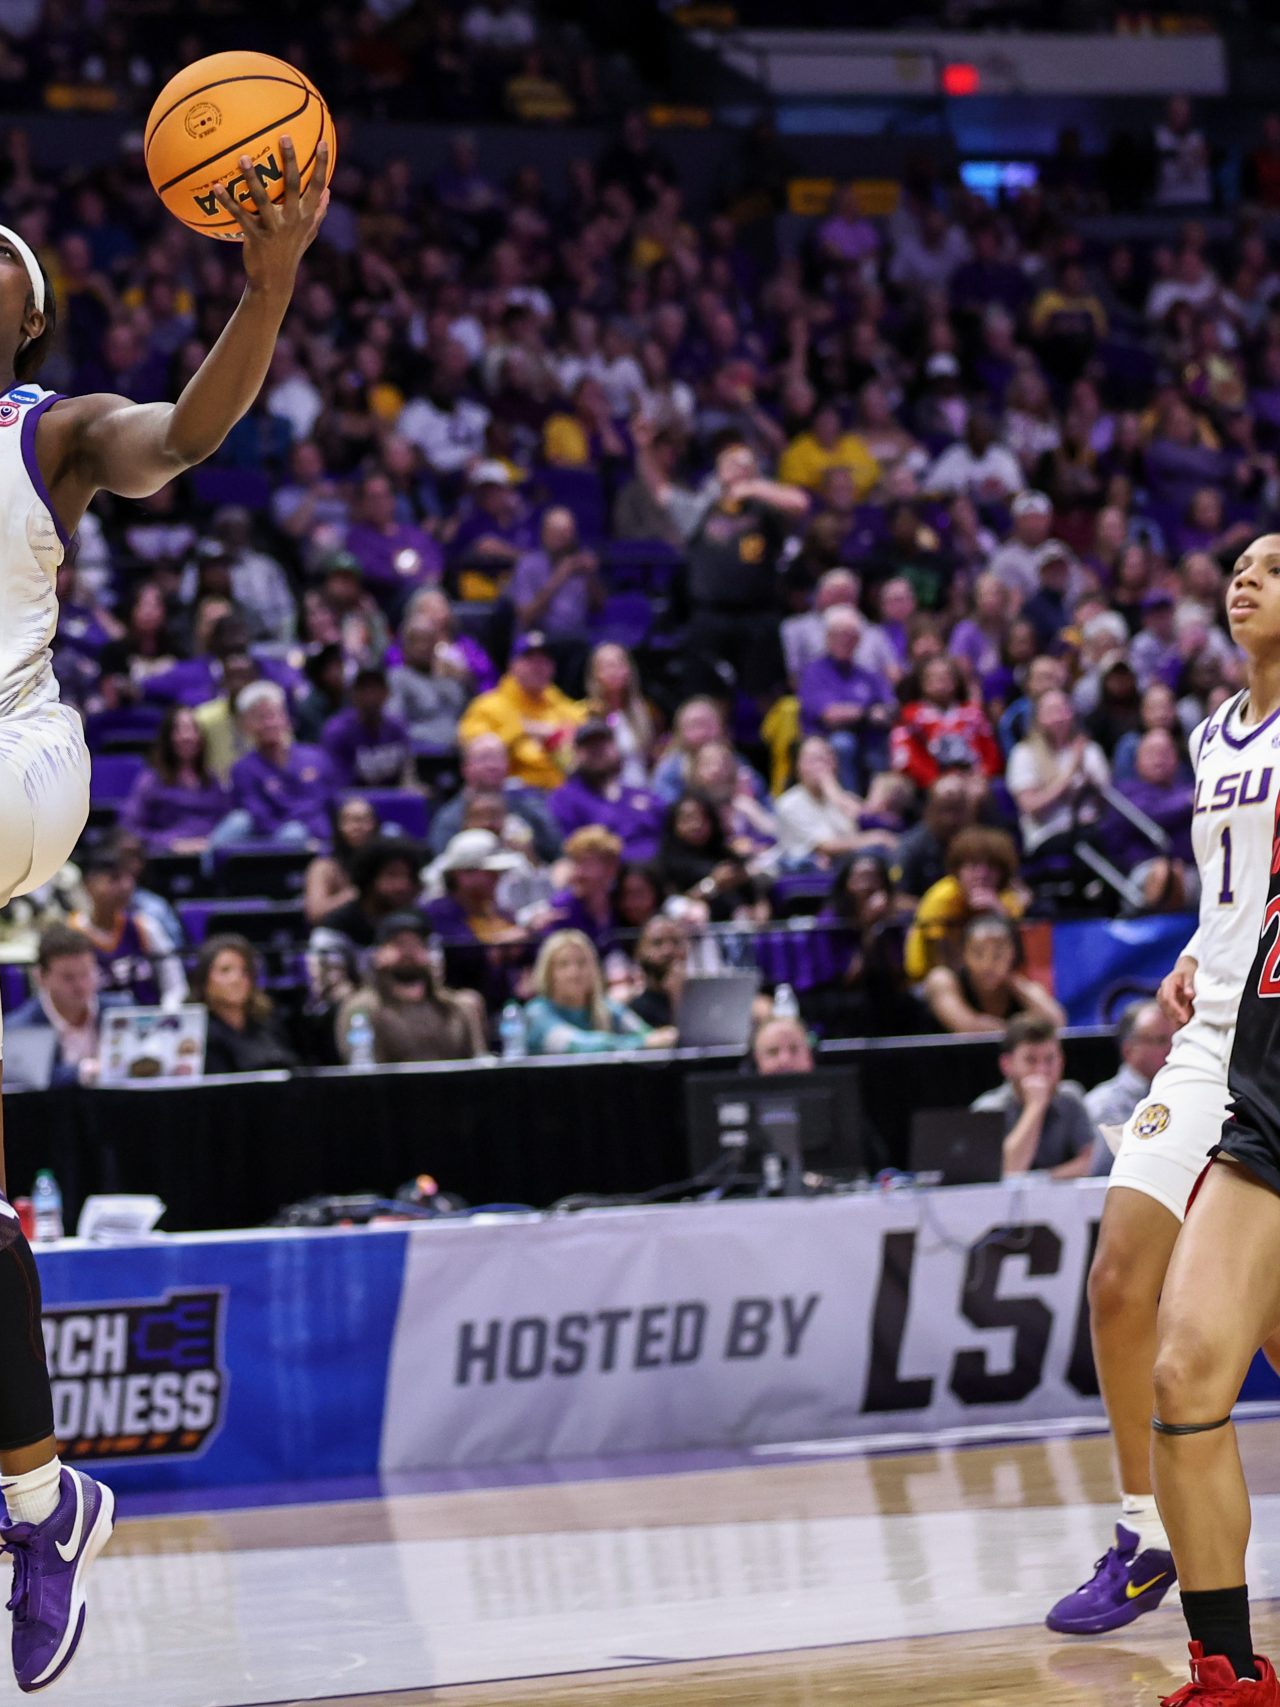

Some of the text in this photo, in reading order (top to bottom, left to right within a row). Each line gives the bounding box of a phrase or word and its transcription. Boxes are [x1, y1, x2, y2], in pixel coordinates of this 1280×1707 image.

[1193, 767, 1275, 816] LSU
[1218, 824, 1236, 907] 1
[453, 1293, 821, 1387] HOSTED BY
